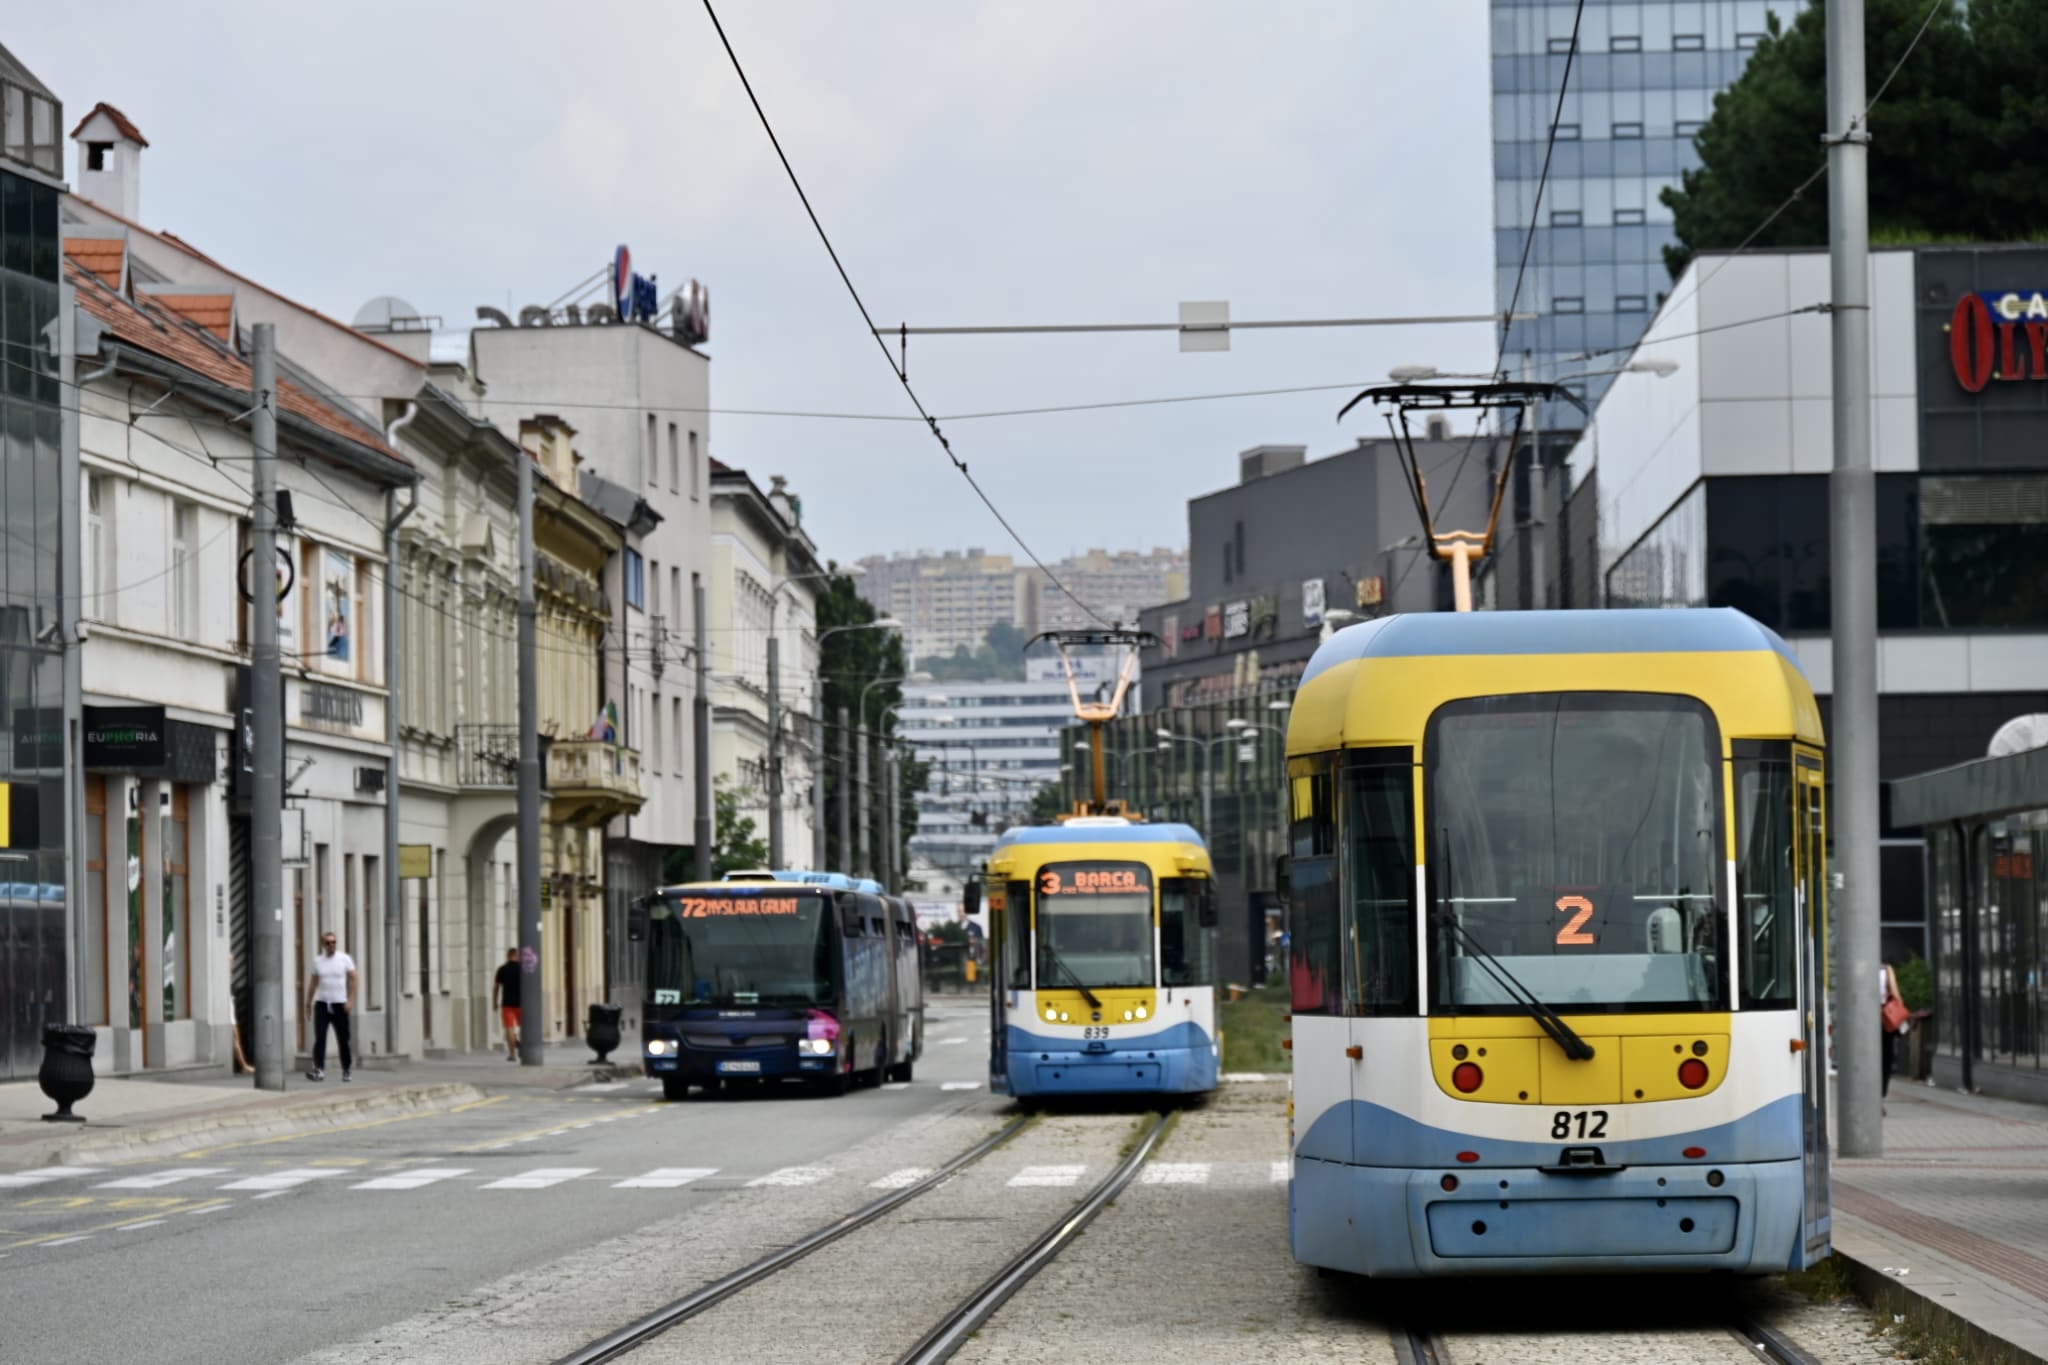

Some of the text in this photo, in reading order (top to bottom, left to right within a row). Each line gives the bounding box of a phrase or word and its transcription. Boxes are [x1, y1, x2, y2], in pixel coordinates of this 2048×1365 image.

[87, 730, 158, 743] EUPHORIA
[1040, 872, 1060, 895] 3
[1075, 871, 1135, 887] BARCA
[681, 898, 706, 918] 72
[1555, 896, 1594, 944] 2
[1084, 1026, 1109, 1039] 839
[1551, 1110, 1609, 1139] 812
